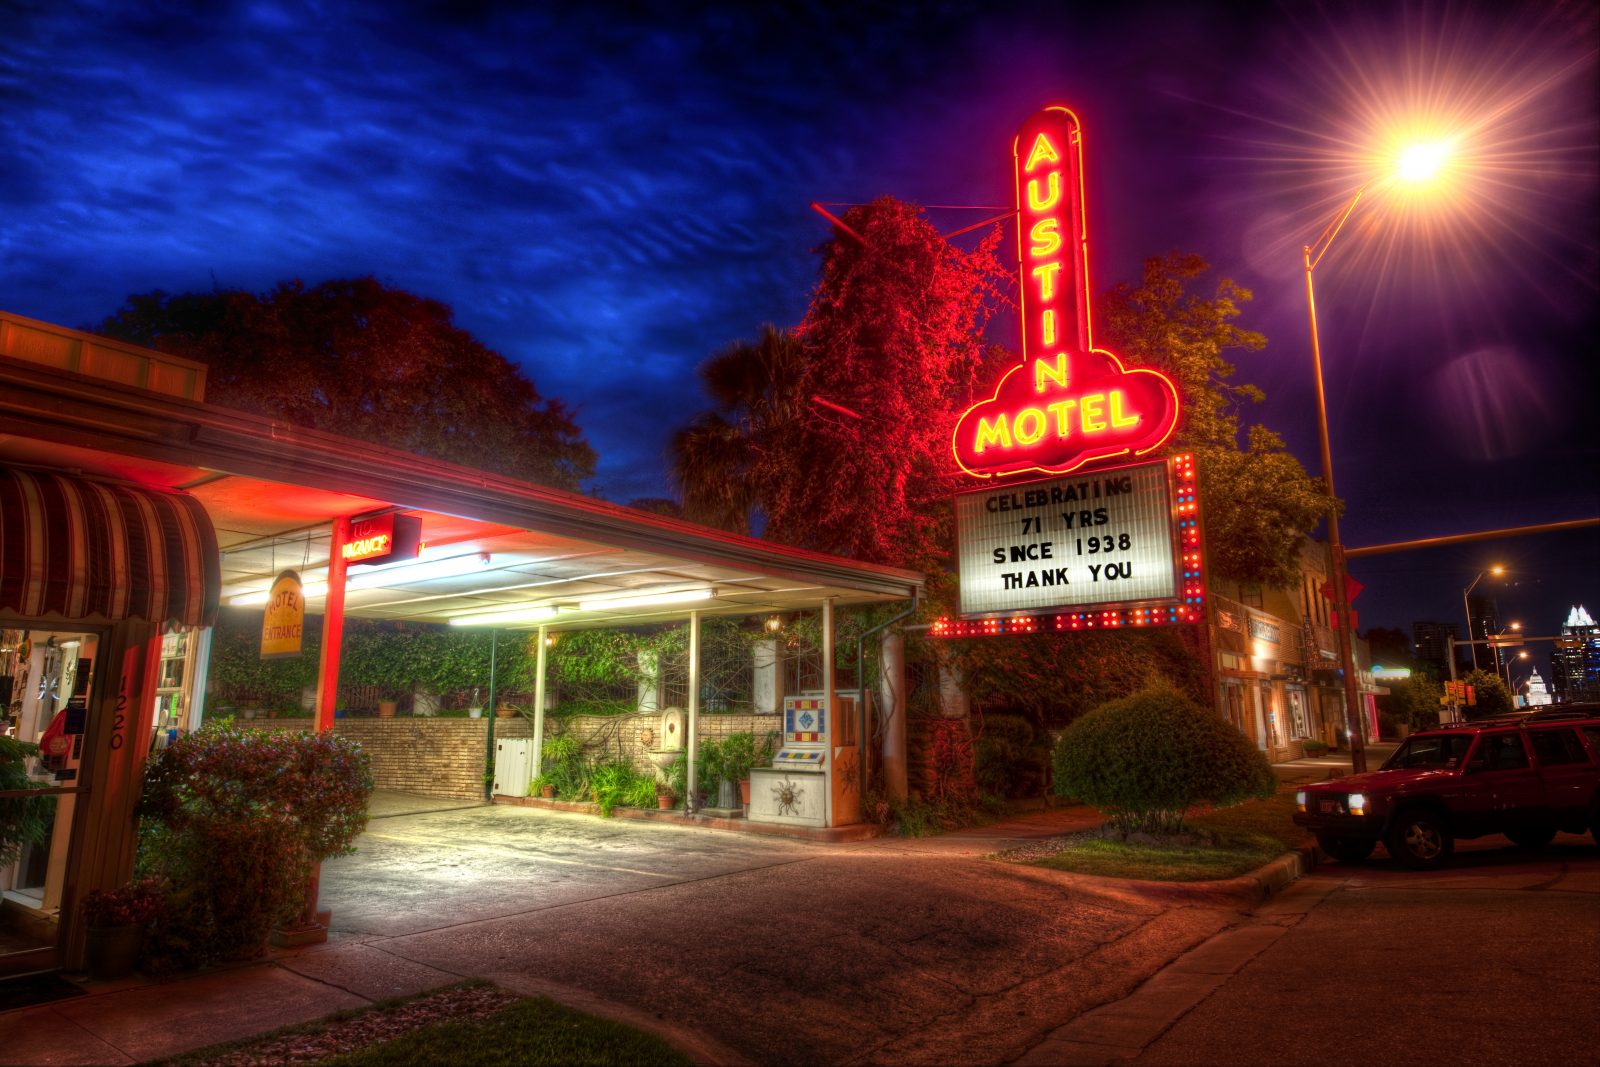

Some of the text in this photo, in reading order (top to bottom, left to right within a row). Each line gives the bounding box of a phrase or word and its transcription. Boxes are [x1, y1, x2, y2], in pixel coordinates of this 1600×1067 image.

[1024, 132, 1069, 393] AUSTIN
[974, 390, 1140, 454] MOTEL
[985, 476, 1133, 513] CELEBRATING
[1021, 507, 1109, 536] 71 YRS
[1076, 533, 1132, 556] 1938
[1001, 561, 1132, 590] THANK YOU
[263, 623, 302, 641] ENTRANCE
[110, 676, 126, 750] 1220
